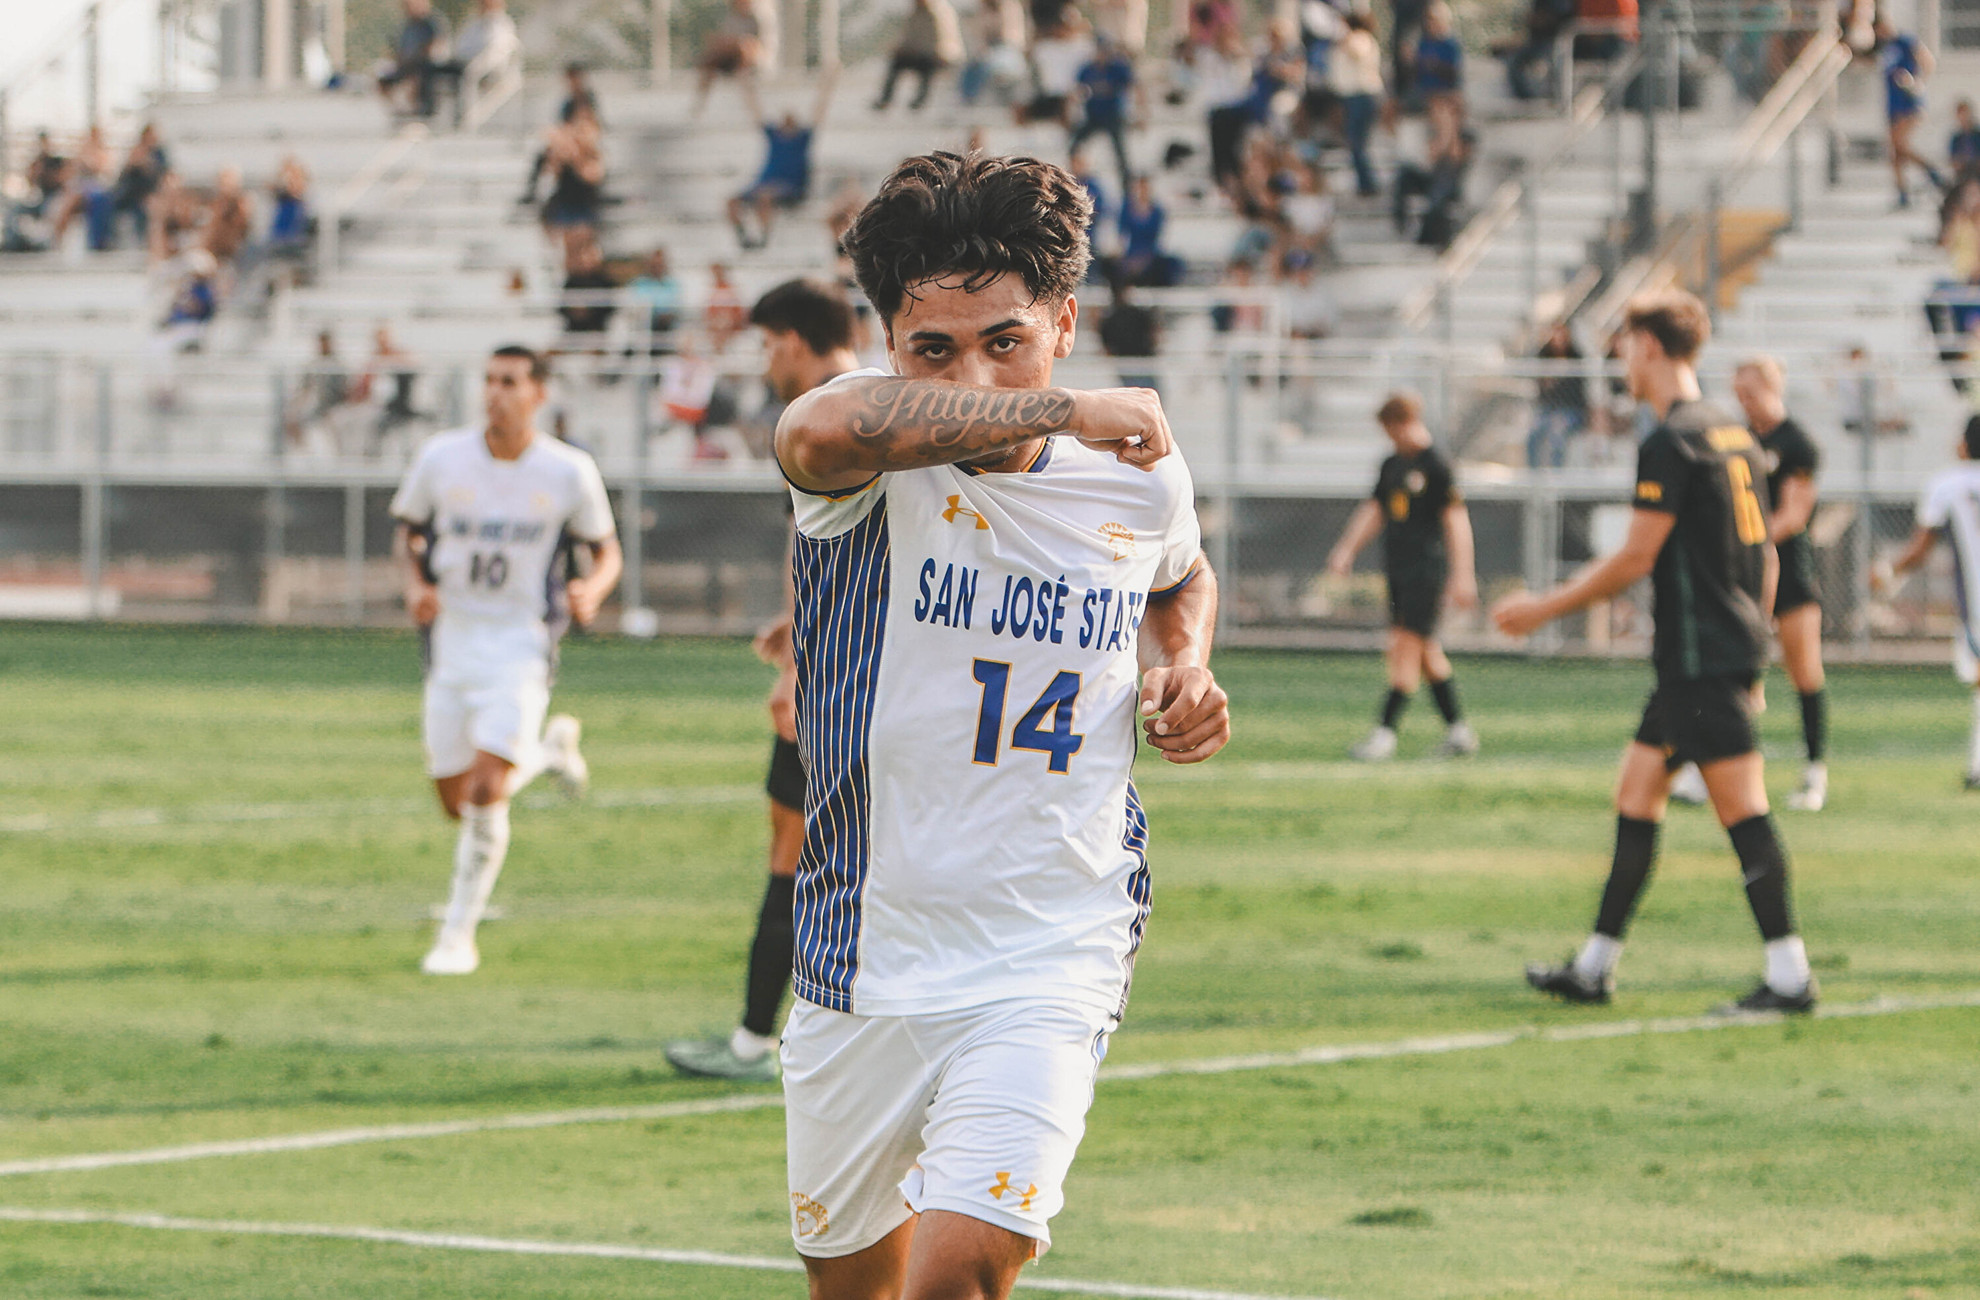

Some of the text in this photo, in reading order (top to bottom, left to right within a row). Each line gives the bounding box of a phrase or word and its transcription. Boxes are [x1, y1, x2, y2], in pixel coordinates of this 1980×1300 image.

[470, 551, 508, 589] 10
[914, 557, 979, 631] SAN
[992, 574, 1069, 644] JOSÉ
[971, 656, 1086, 775] 14
